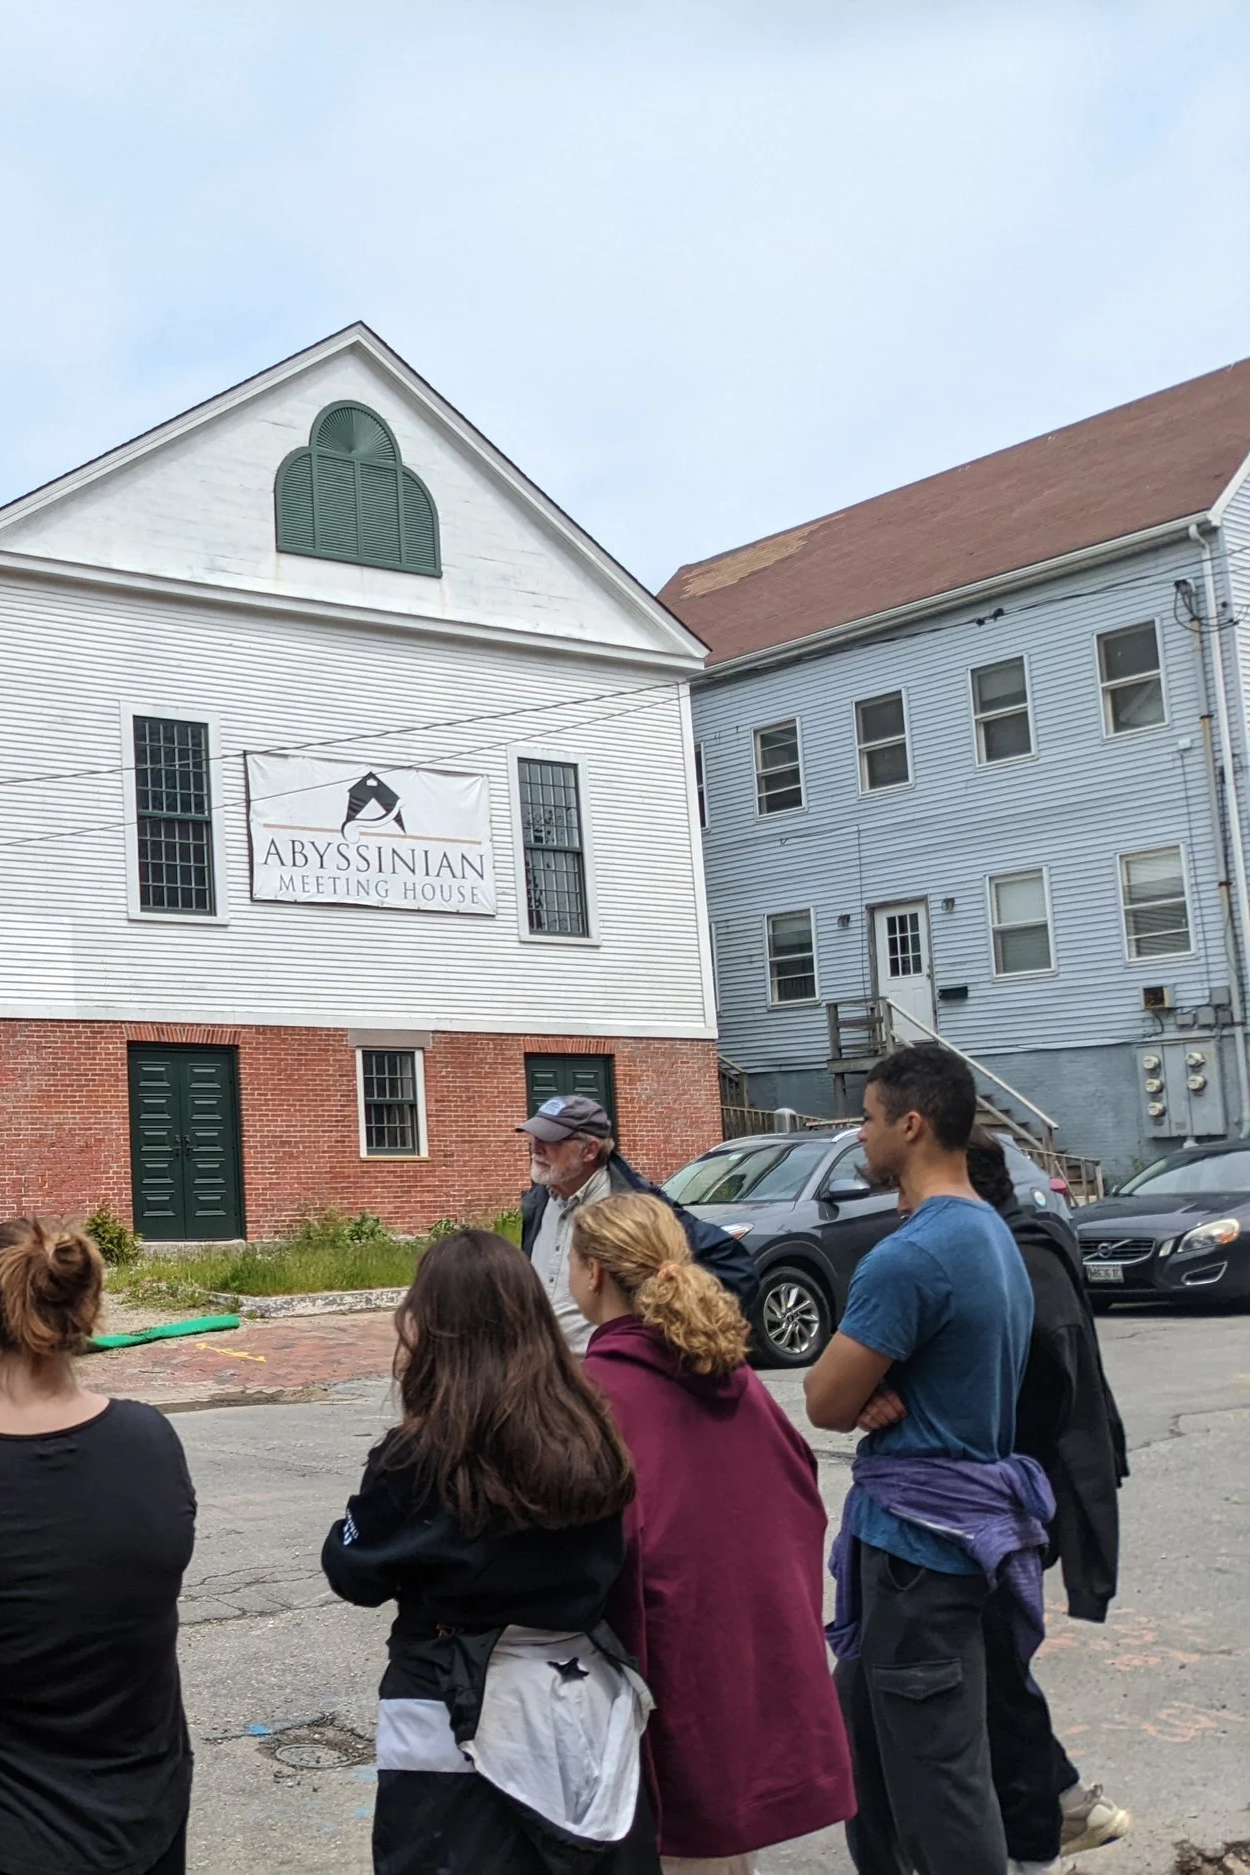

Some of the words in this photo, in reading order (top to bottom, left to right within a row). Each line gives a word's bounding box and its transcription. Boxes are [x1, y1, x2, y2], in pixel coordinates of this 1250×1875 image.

[263, 838, 485, 880] ABYSSINIAN
[279, 873, 390, 898] MEETING
[403, 882, 480, 904] HOUSE
